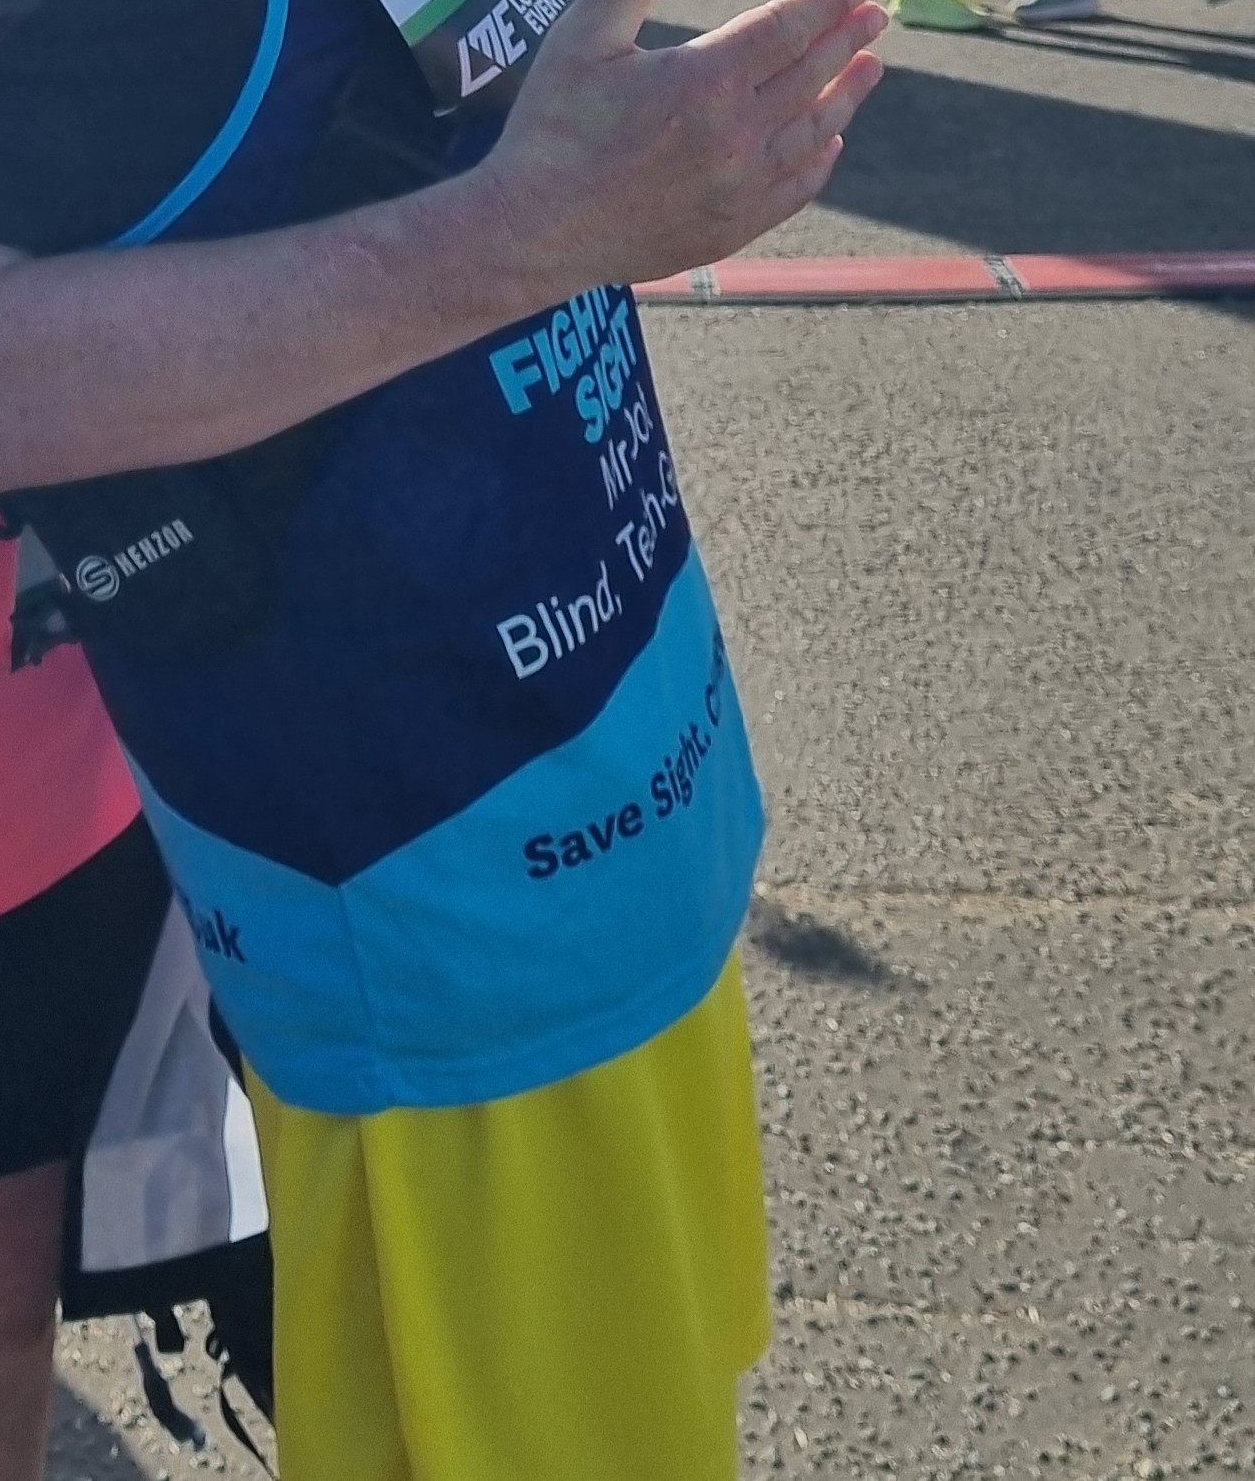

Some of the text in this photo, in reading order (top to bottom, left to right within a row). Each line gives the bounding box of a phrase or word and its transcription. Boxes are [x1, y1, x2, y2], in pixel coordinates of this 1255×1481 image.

[575, 297, 638, 444] SIGHT
[599, 437, 634, 511] Mr
[496, 559, 623, 681] Blind,
[522, 721, 713, 881] Save Sight.
